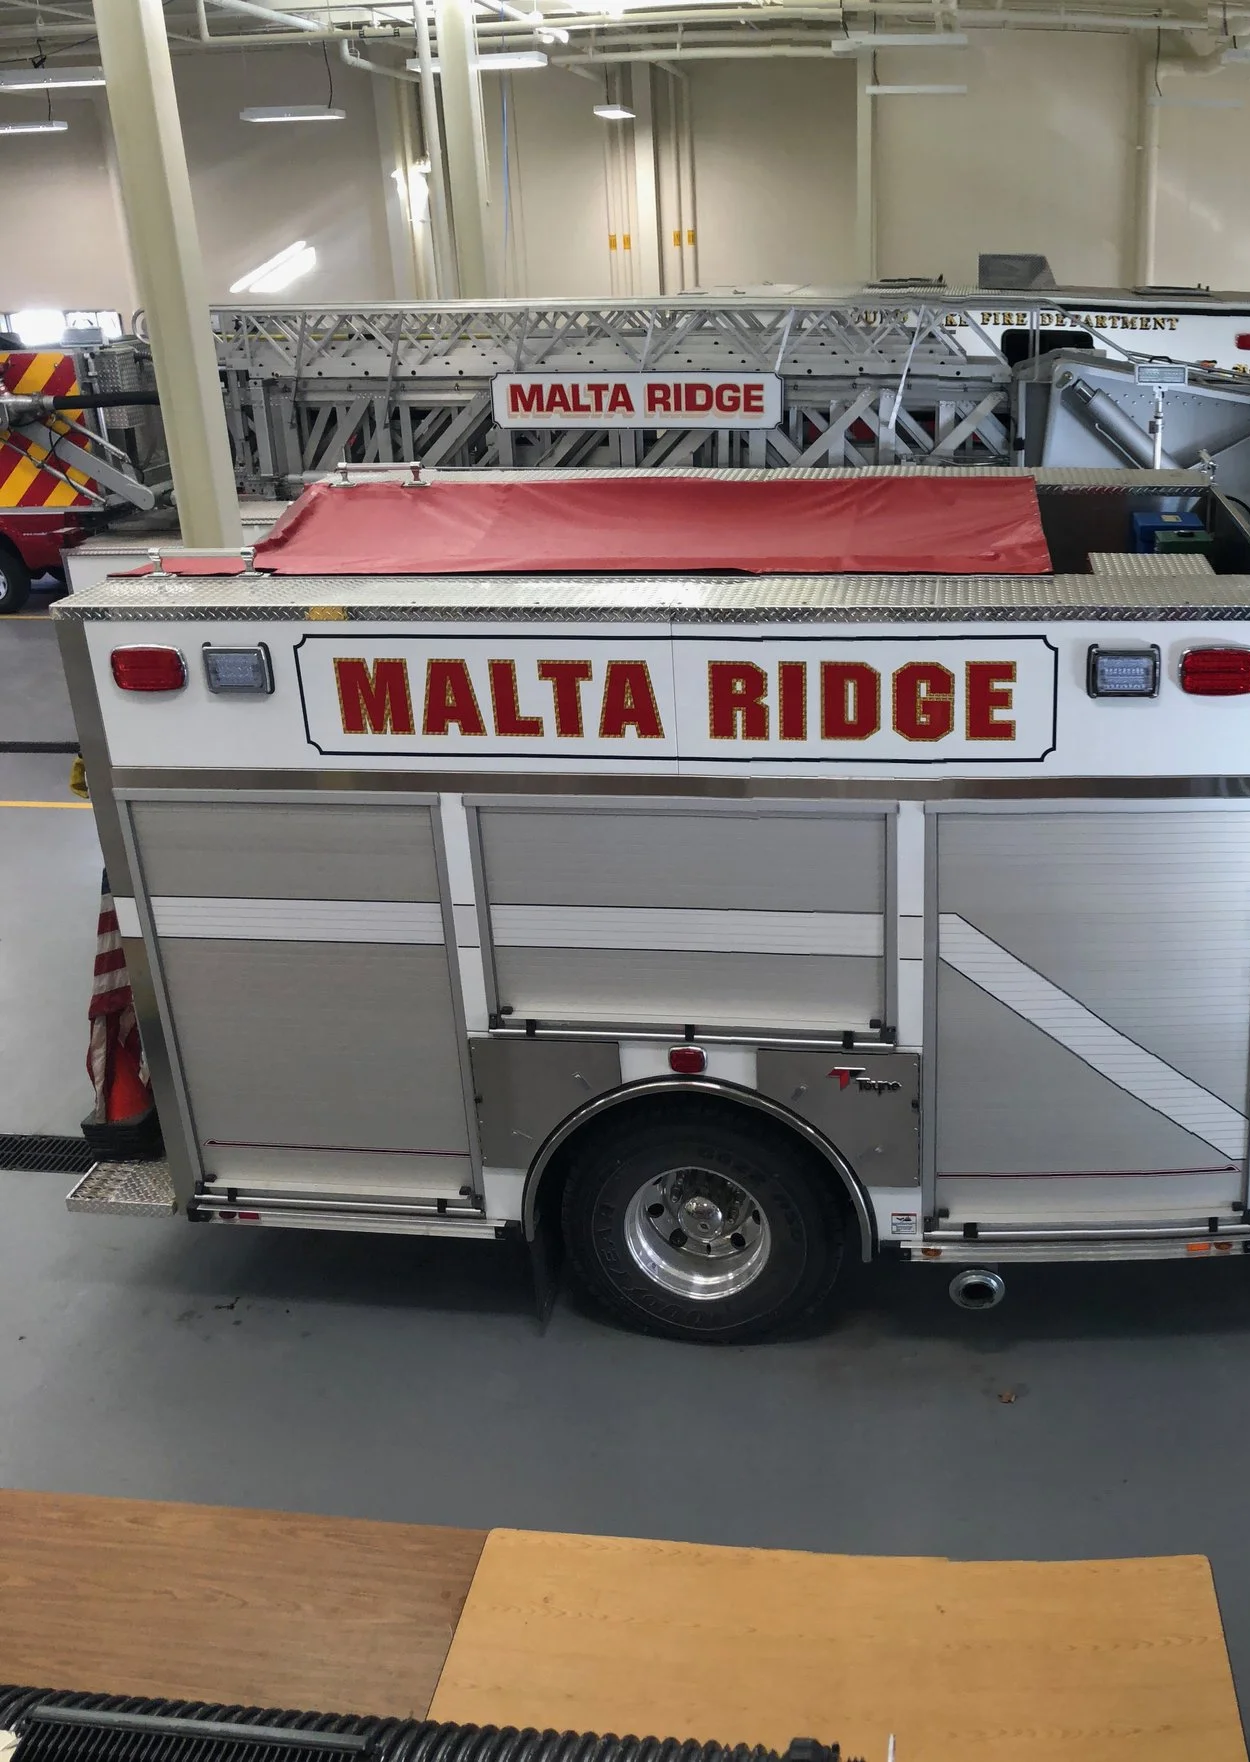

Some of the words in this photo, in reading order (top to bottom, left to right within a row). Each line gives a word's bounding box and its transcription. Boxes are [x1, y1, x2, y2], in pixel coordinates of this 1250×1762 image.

[980, 311, 1028, 326] FIRE
[1040, 312, 1179, 331] DEPARTMENT
[508, 383, 636, 415] MALTA
[646, 383, 765, 415] RIDGE
[333, 657, 665, 738] MALTA
[708, 660, 1017, 742] RIDGE
[856, 1077, 902, 1097] Toyne
